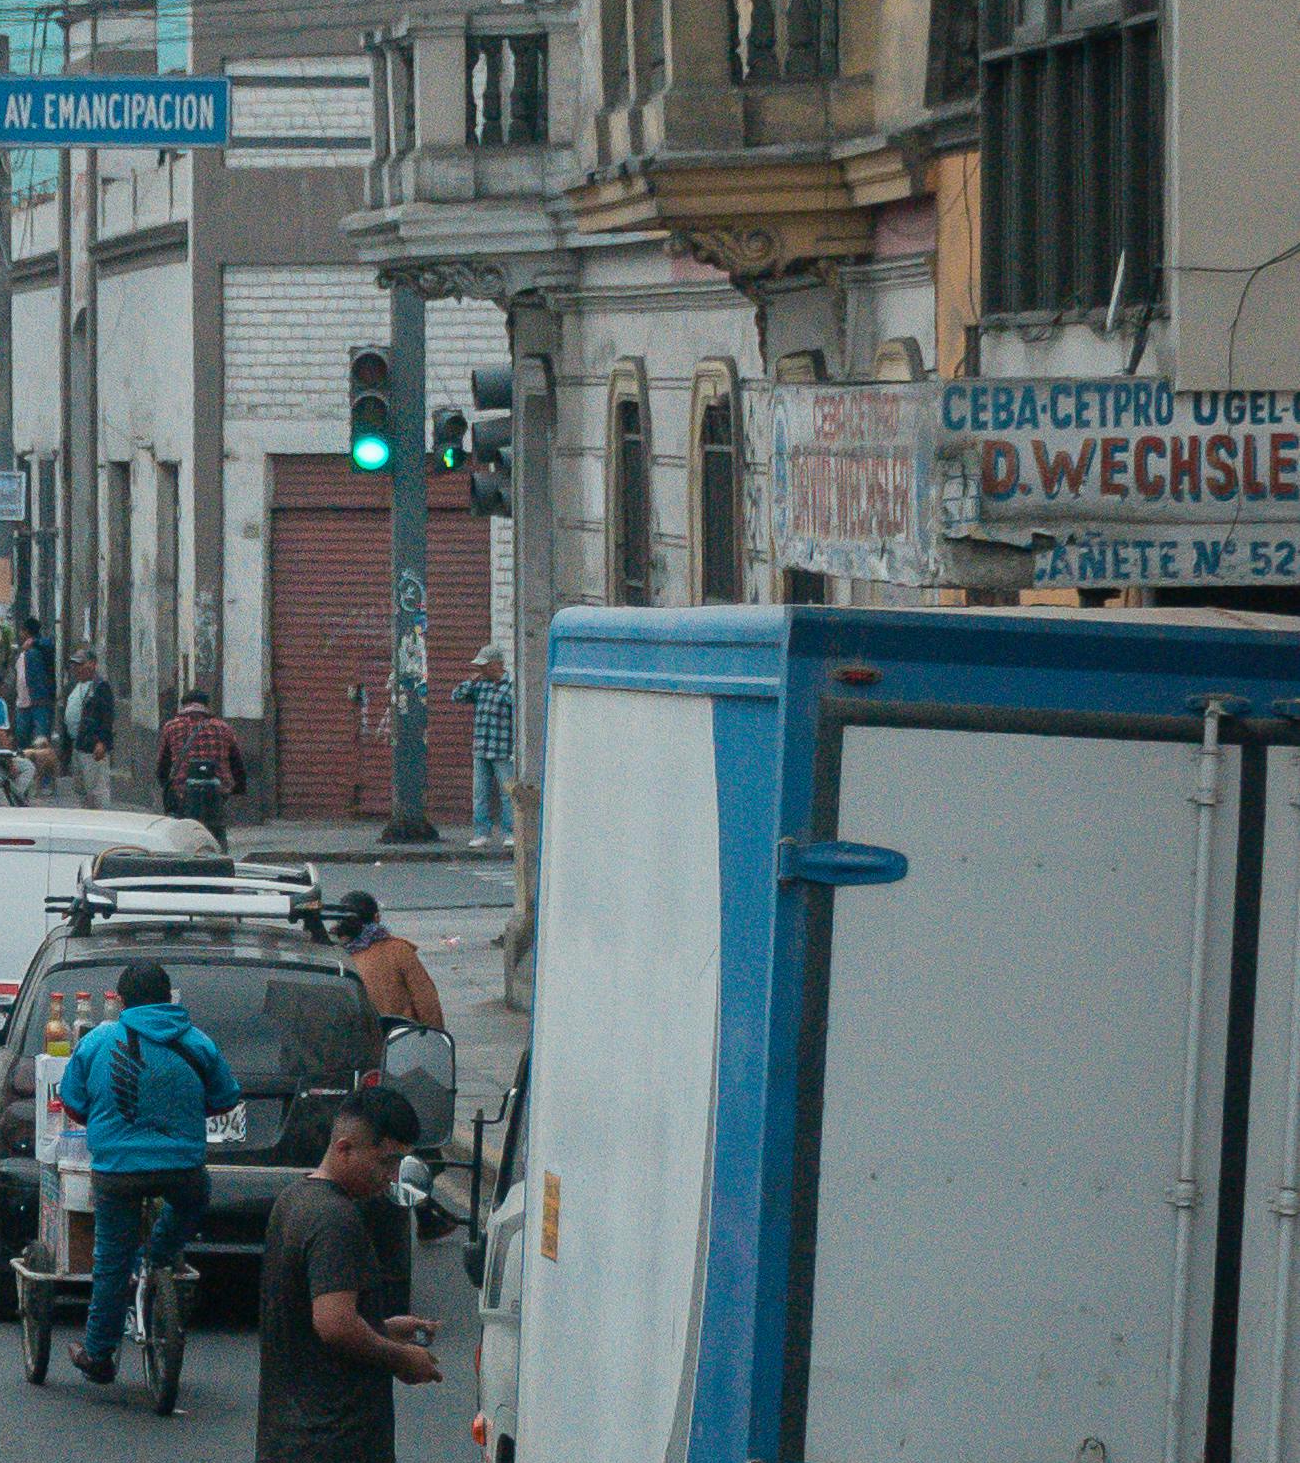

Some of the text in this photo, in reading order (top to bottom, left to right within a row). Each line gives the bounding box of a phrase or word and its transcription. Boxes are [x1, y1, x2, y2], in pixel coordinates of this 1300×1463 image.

[4, 92, 215, 131] AV. EMANCIPACION
[1192, 390, 1300, 426] UGEL-
[1250, 540, 1300, 577] 52
